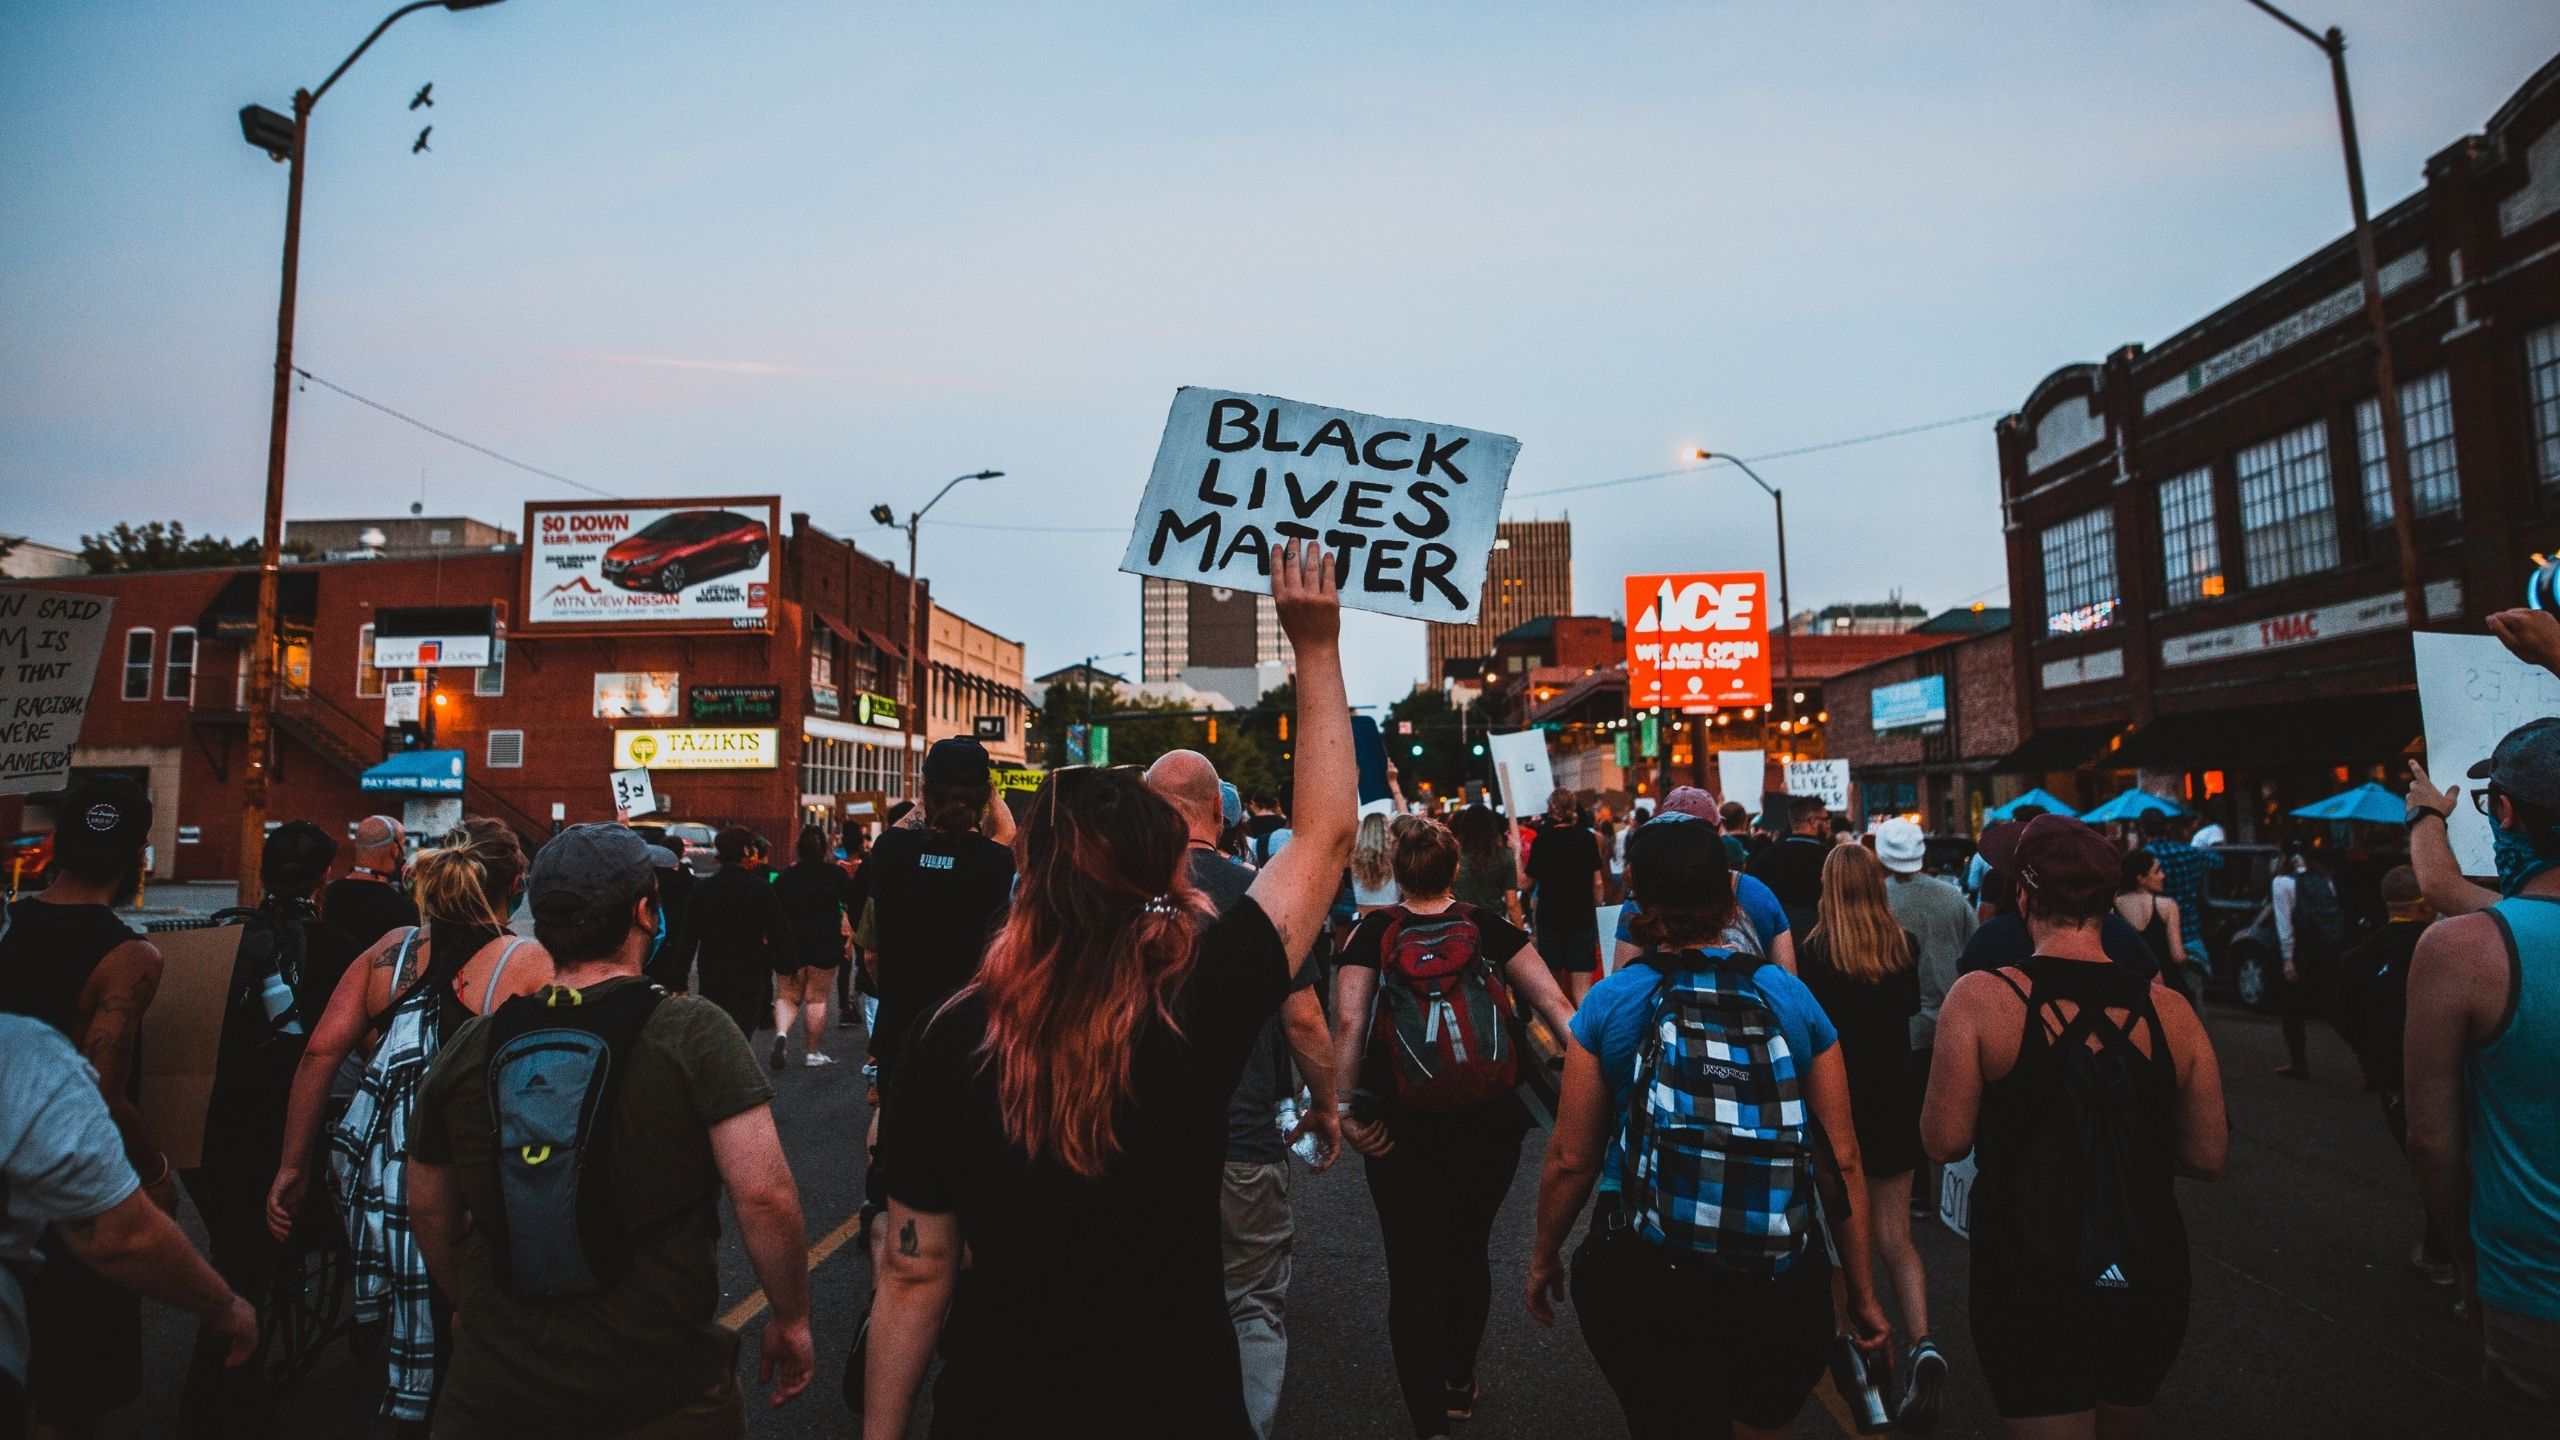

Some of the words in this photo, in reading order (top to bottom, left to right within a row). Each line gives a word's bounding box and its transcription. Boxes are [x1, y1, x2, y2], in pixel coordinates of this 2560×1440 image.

[1206, 398, 1470, 484] BLACK
[1198, 458, 1450, 539] LIVES
[543, 514, 565, 532] $0
[569, 513, 629, 531] DOWN
[590, 594, 624, 607] VIEW
[627, 592, 680, 606] NISSAN
[695, 595, 745, 603] WARRANTY
[701, 587, 741, 596] LIFETIME
[38, 598, 102, 621] SAID
[1634, 578, 1757, 632] ACE
[2258, 610, 2320, 646] TMAC
[36, 630, 70, 652] IS
[1635, 643, 1664, 661] WE
[1668, 641, 1704, 660] ARE
[1708, 640, 1759, 660] OPEN
[17, 662, 71, 683] THAT
[1790, 761, 1832, 775] BLACK
[361, 777, 385, 790] PAY
[386, 777, 418, 789] HERE
[420, 777, 438, 789] PAY
[632, 784, 645, 797] 12
[1791, 775, 1838, 790] LIVES
